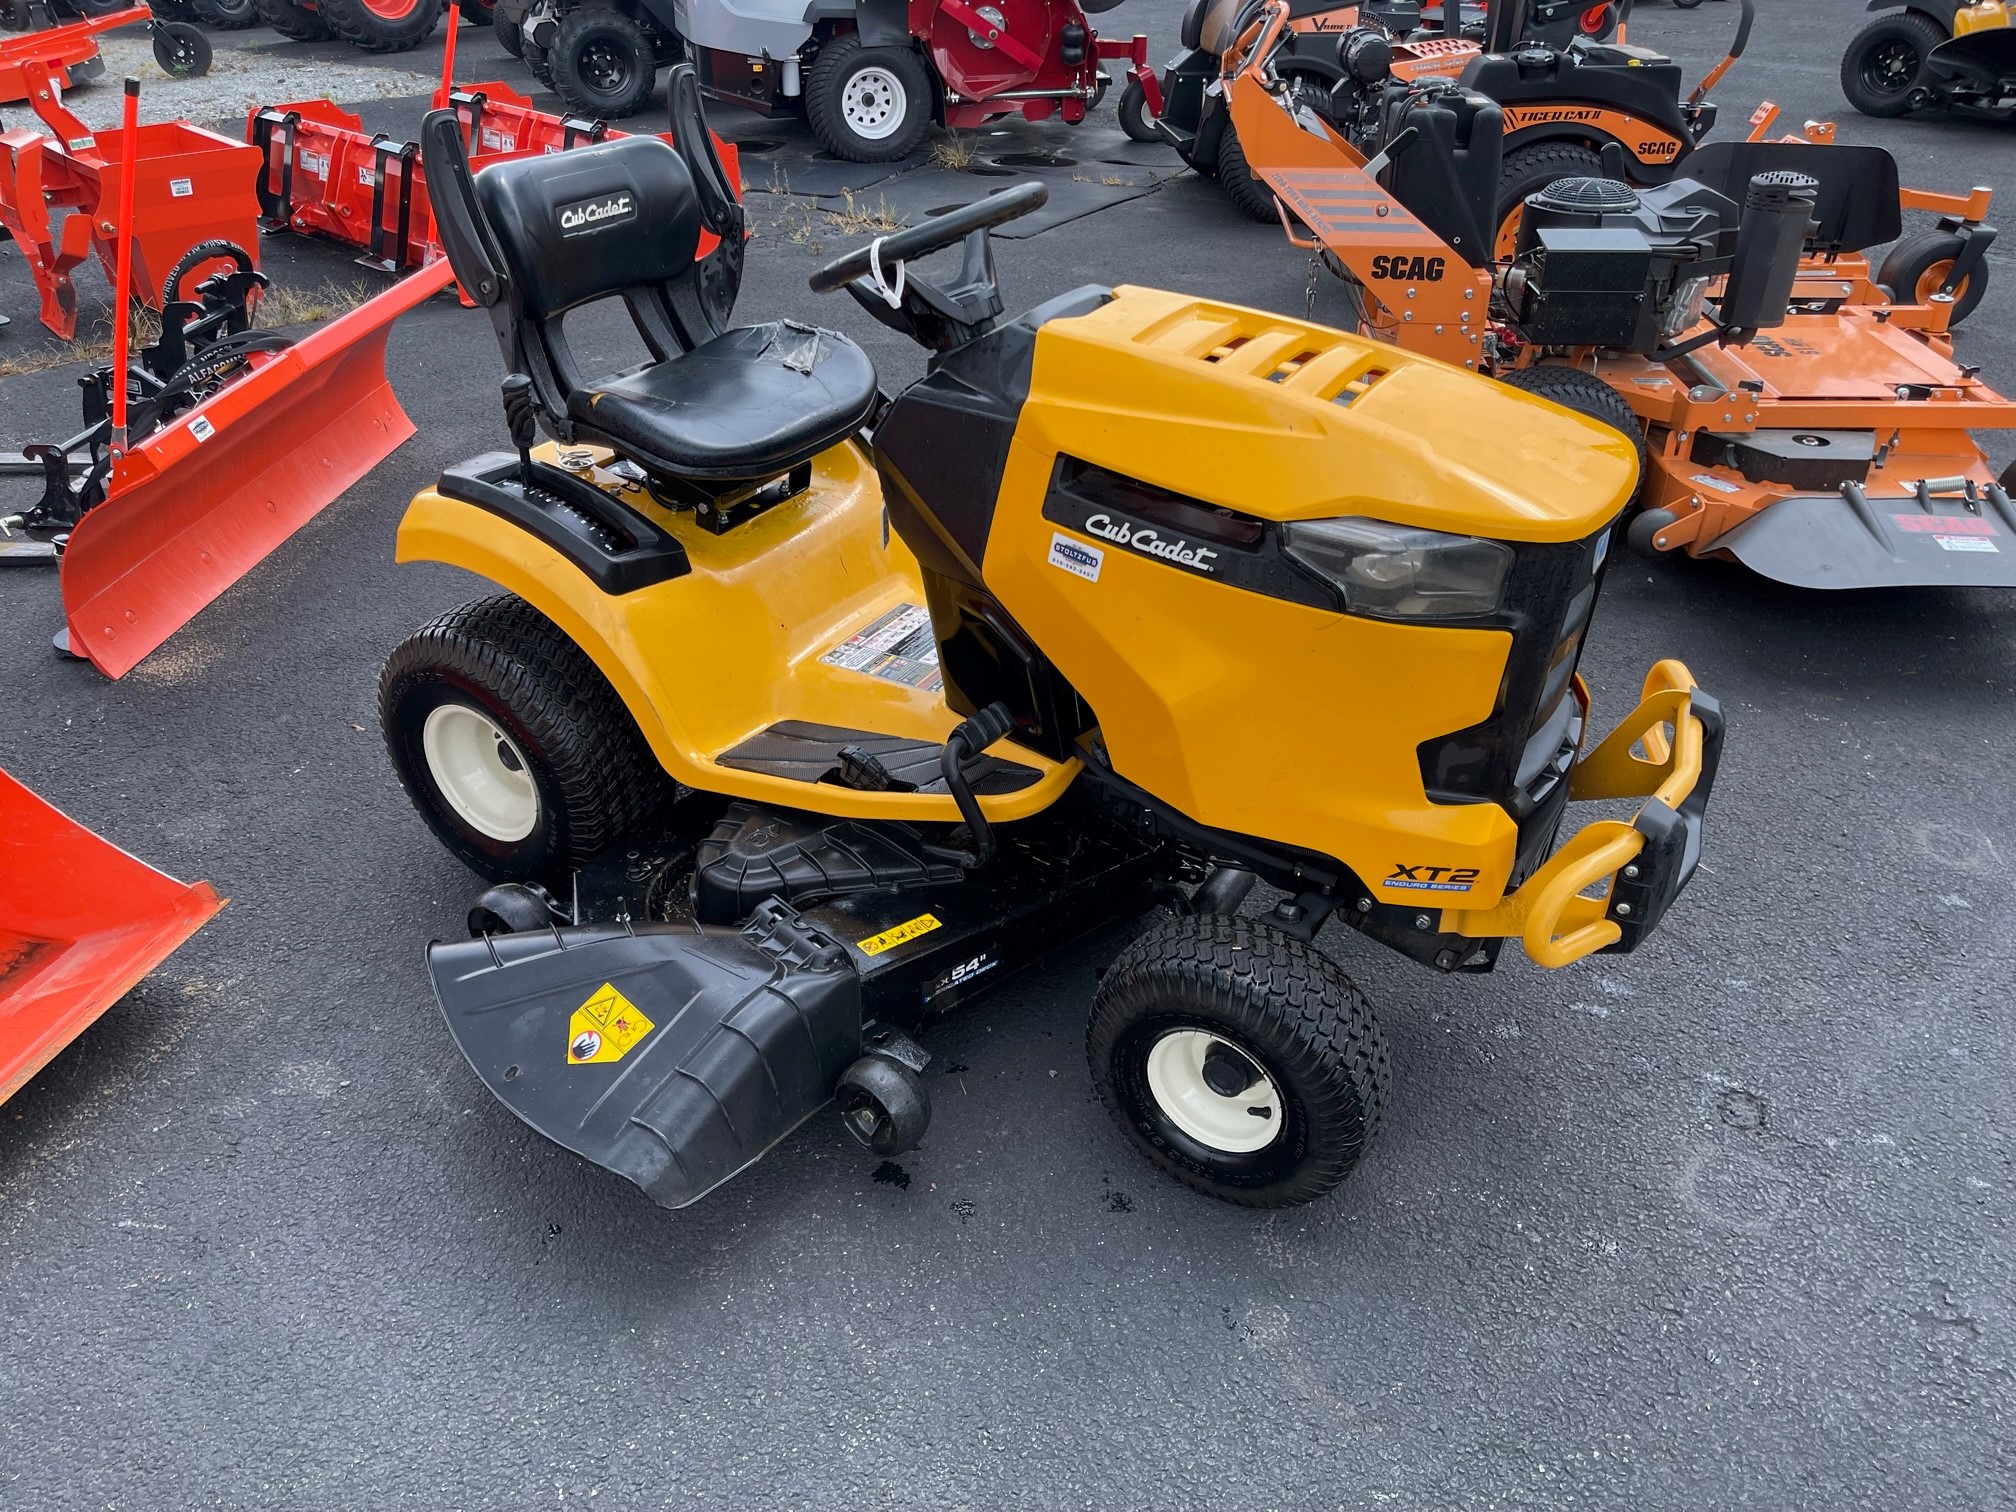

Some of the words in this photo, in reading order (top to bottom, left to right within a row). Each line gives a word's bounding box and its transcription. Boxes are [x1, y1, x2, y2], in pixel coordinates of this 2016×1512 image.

[1520, 111, 1562, 121] TIGER
[1563, 110, 1594, 120] CAT
[1637, 142, 1677, 155] SCAG
[561, 207, 586, 229] Cub
[585, 197, 630, 222] Cadet
[1371, 255, 1446, 282] SCAG
[1894, 514, 1996, 535] SCAG
[1085, 514, 1131, 544] Cub
[1131, 529, 1218, 571] Cadet
[1387, 863, 1481, 884] XT2
[1384, 880, 1428, 889] ENDURO
[1430, 883, 1468, 891] SERIES
